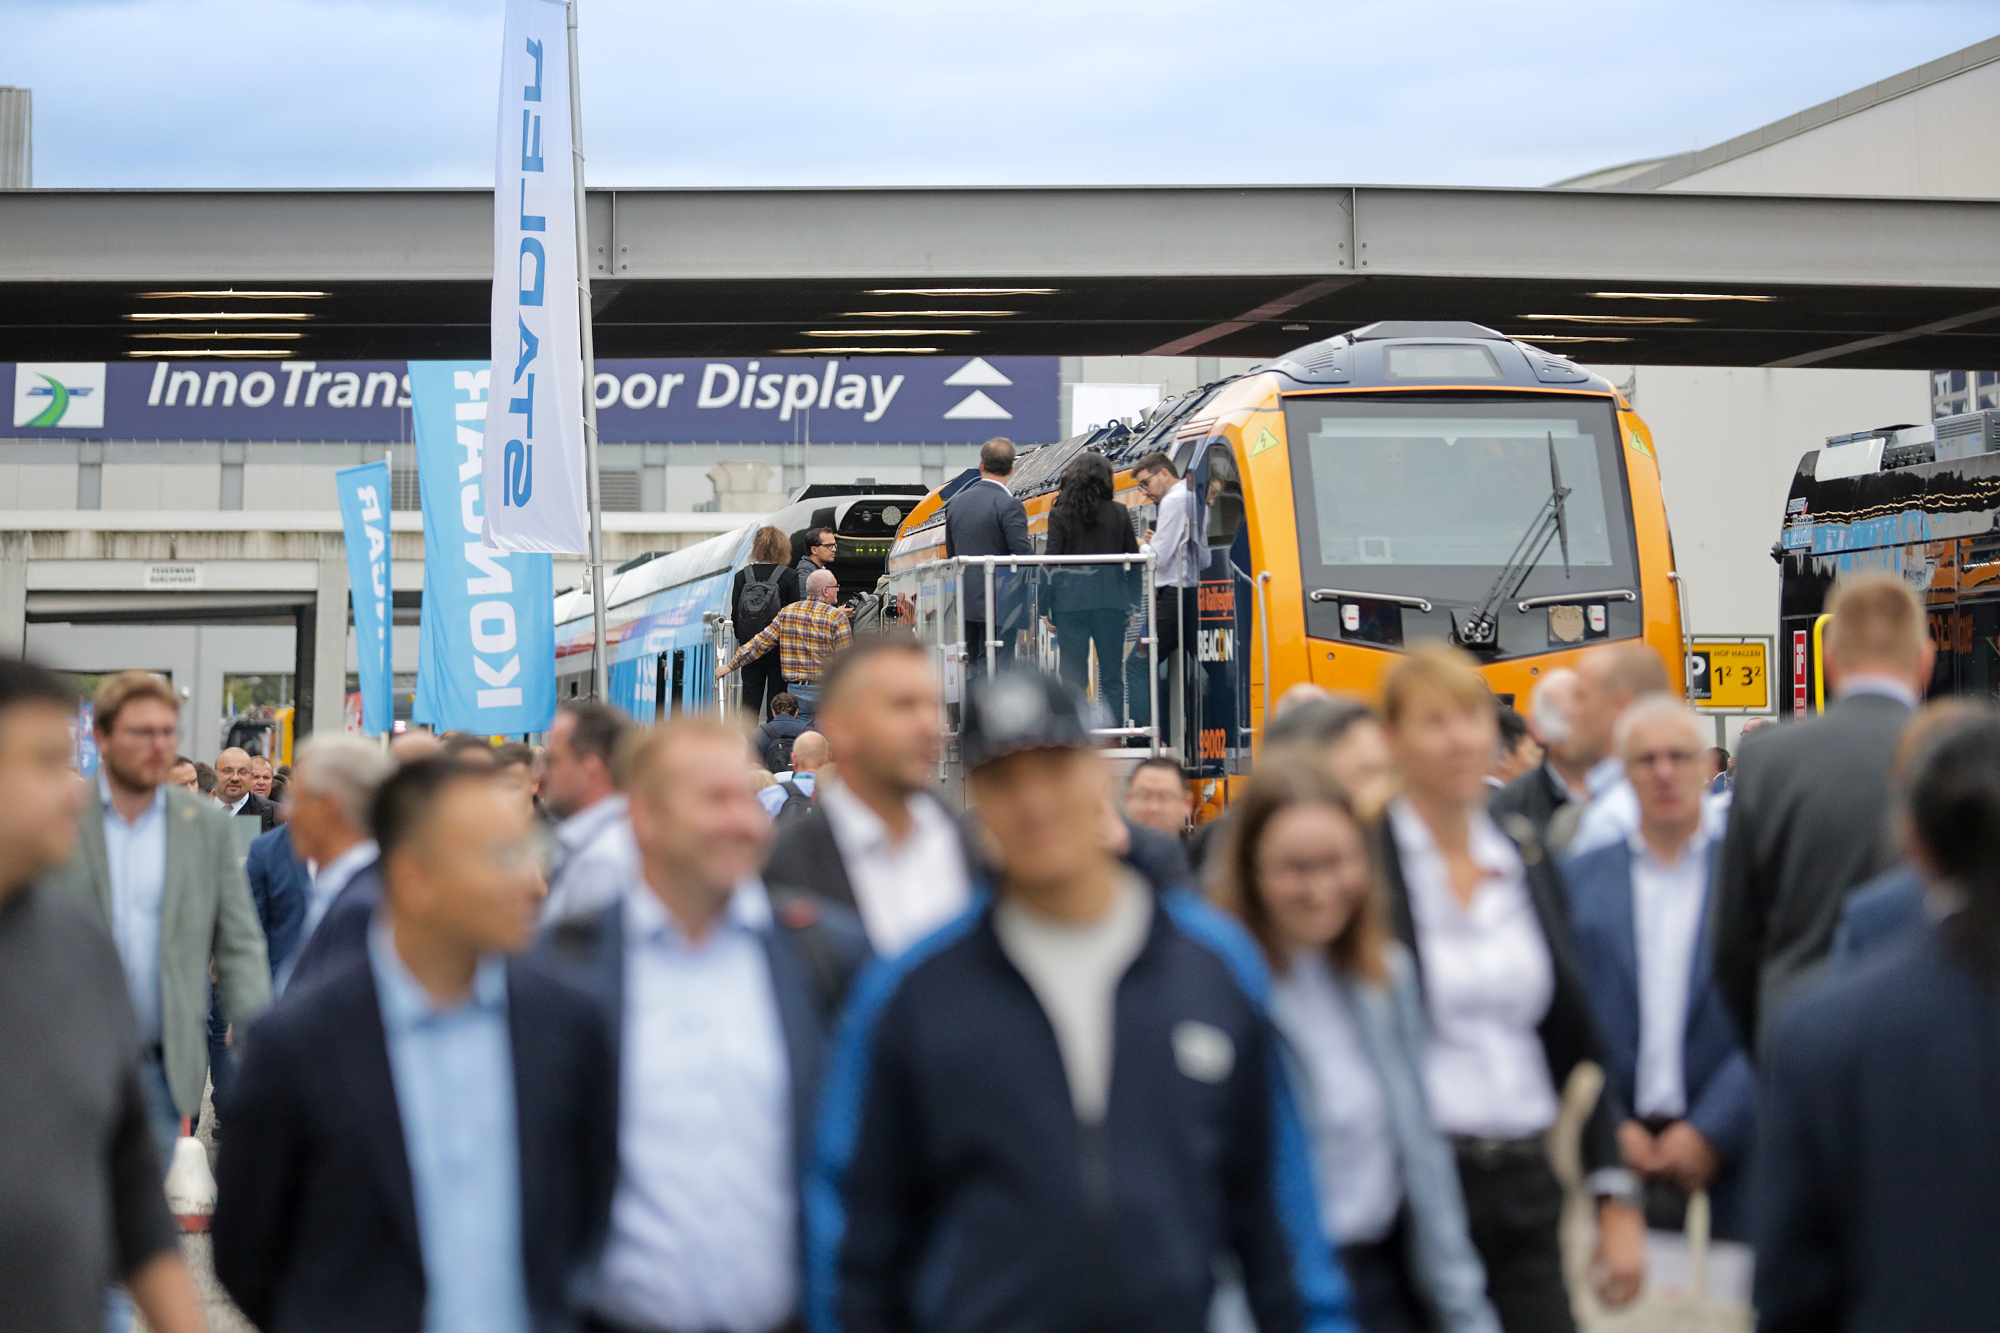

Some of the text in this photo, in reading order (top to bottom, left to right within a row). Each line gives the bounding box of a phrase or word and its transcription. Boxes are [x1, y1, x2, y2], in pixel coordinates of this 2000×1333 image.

[594, 372, 685, 410] oor
[696, 360, 906, 422] Display
[1197, 627, 1234, 662] BEACON
[1714, 649, 1761, 657] HOF HALLEN
[1685, 655, 1706, 687] P
[1198, 728, 1227, 759] 99002
